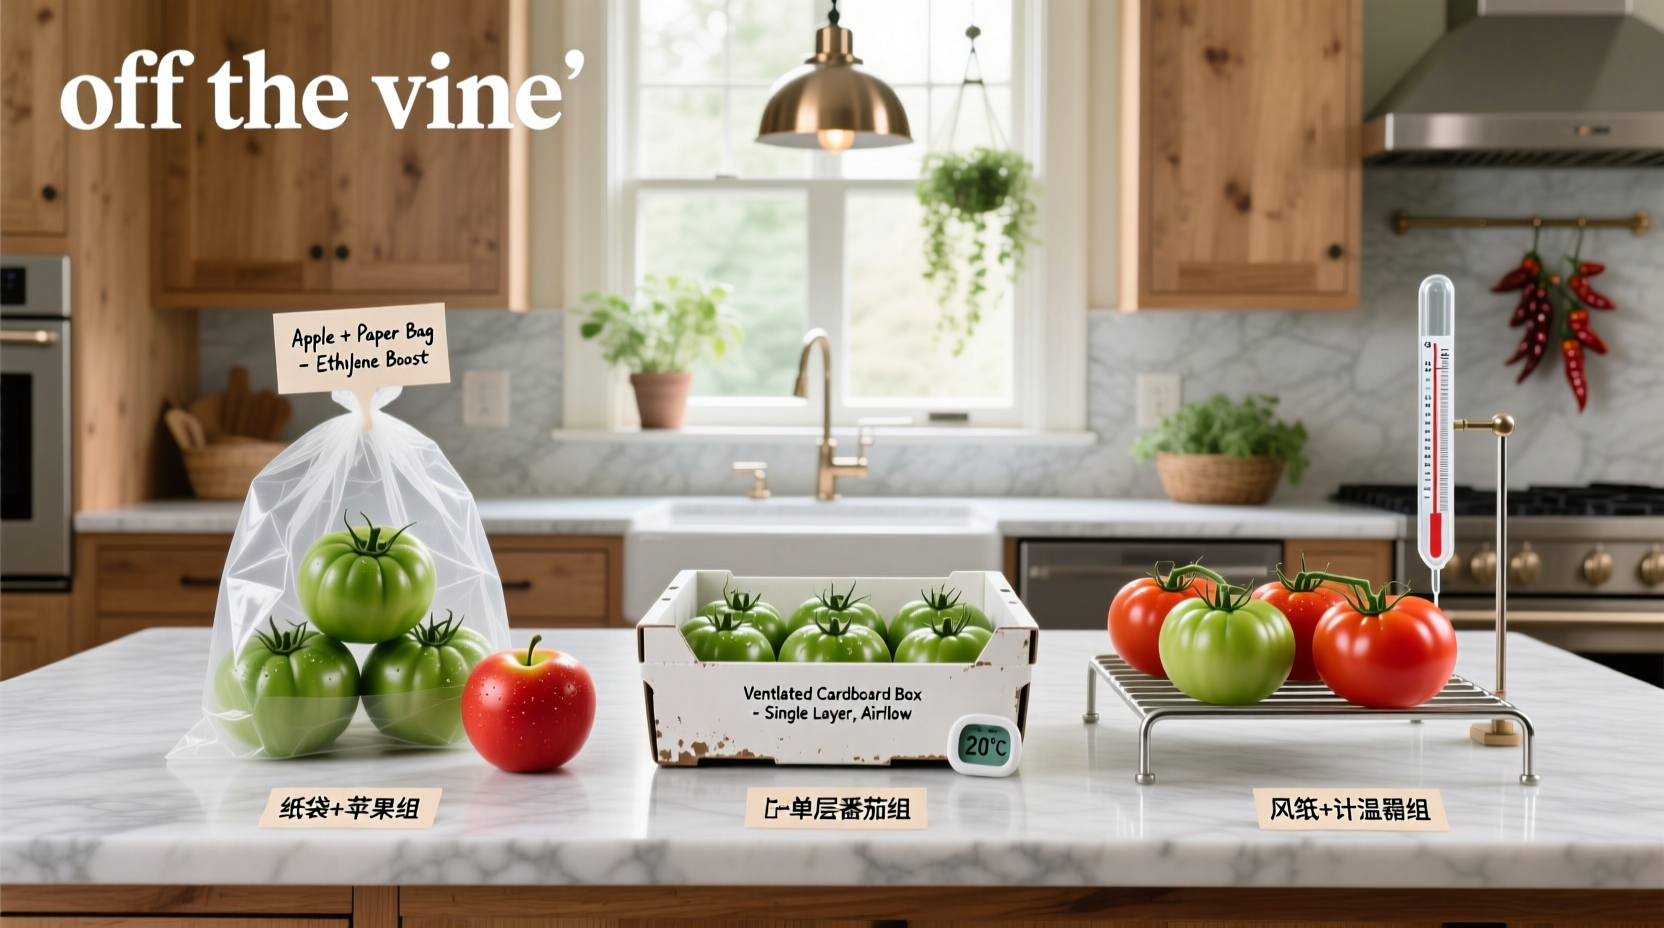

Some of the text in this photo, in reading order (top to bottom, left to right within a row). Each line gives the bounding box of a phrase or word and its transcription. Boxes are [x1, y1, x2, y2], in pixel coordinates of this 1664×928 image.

[291, 321, 434, 353] Apple + Paper Bag
[386, 349, 430, 368] Boost
[816, 685, 891, 701] Cardboard
[894, 686, 922, 702] Box
[764, 705, 809, 724] Single
[813, 706, 857, 724] Layer,
[965, 735, 1007, 757] 20°C
[278, 795, 421, 821] 纸袋+苹果组
